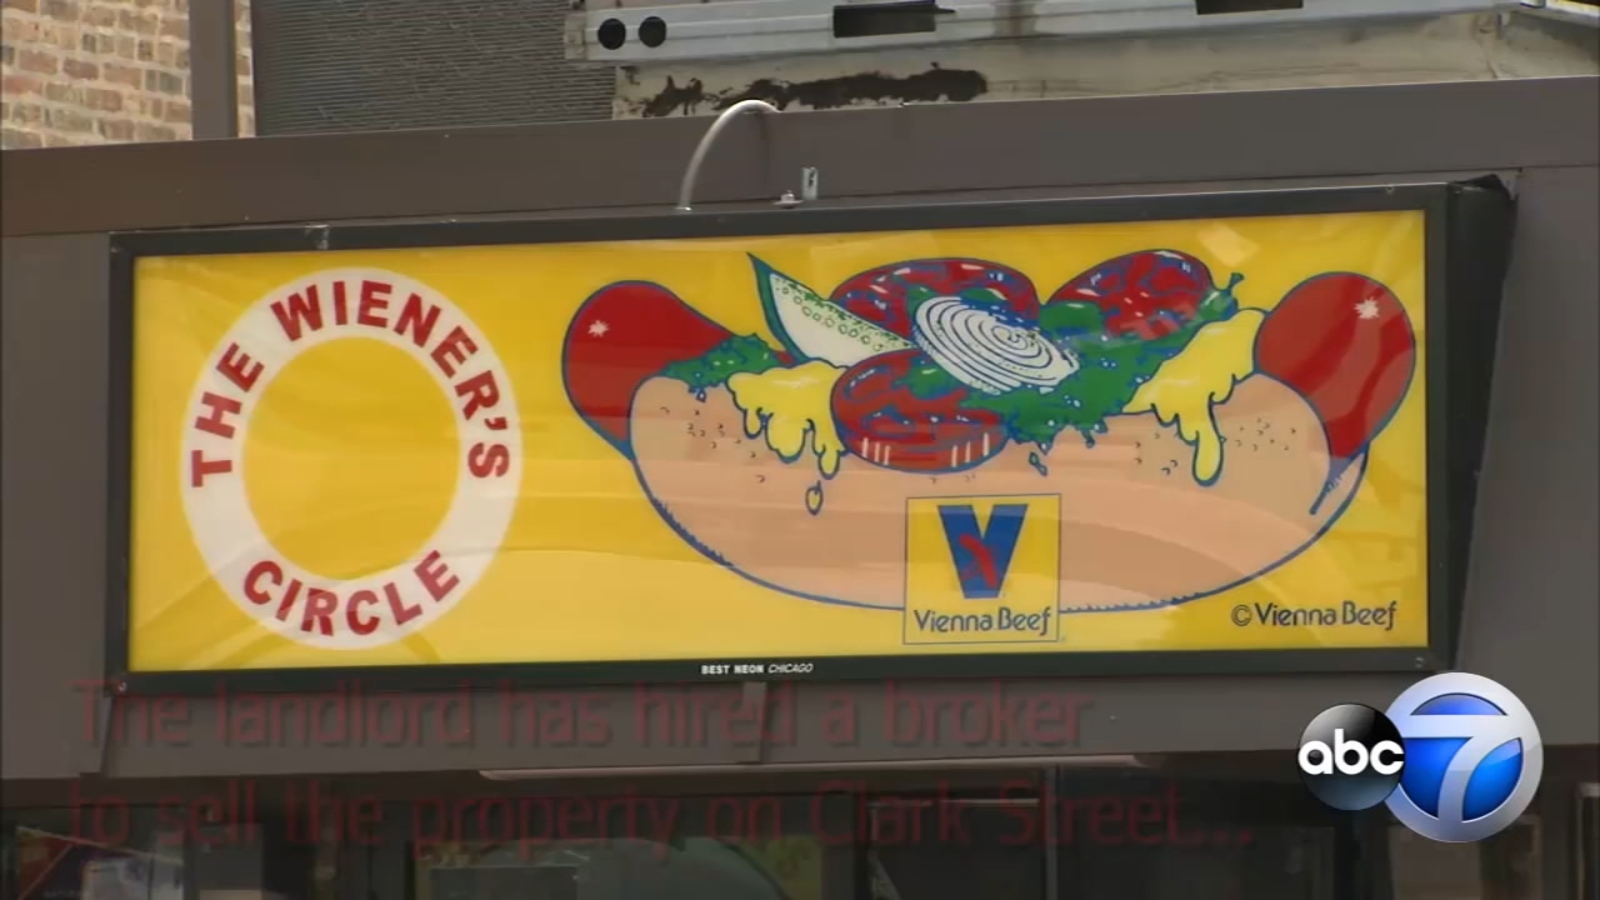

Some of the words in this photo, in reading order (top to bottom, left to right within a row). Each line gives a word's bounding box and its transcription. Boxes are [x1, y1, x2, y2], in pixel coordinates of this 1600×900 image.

[191, 342, 265, 487] THE
[270, 280, 510, 478] WIENER'S
[243, 550, 460, 636] CIRCLE
[914, 609, 993, 632] Vienna
[998, 605, 1051, 637] Beef
[1343, 600, 1397, 631] Beef
[701, 664, 731, 675] BEST
[734, 664, 764, 674] NEON
[768, 663, 814, 674] CHICAGO
